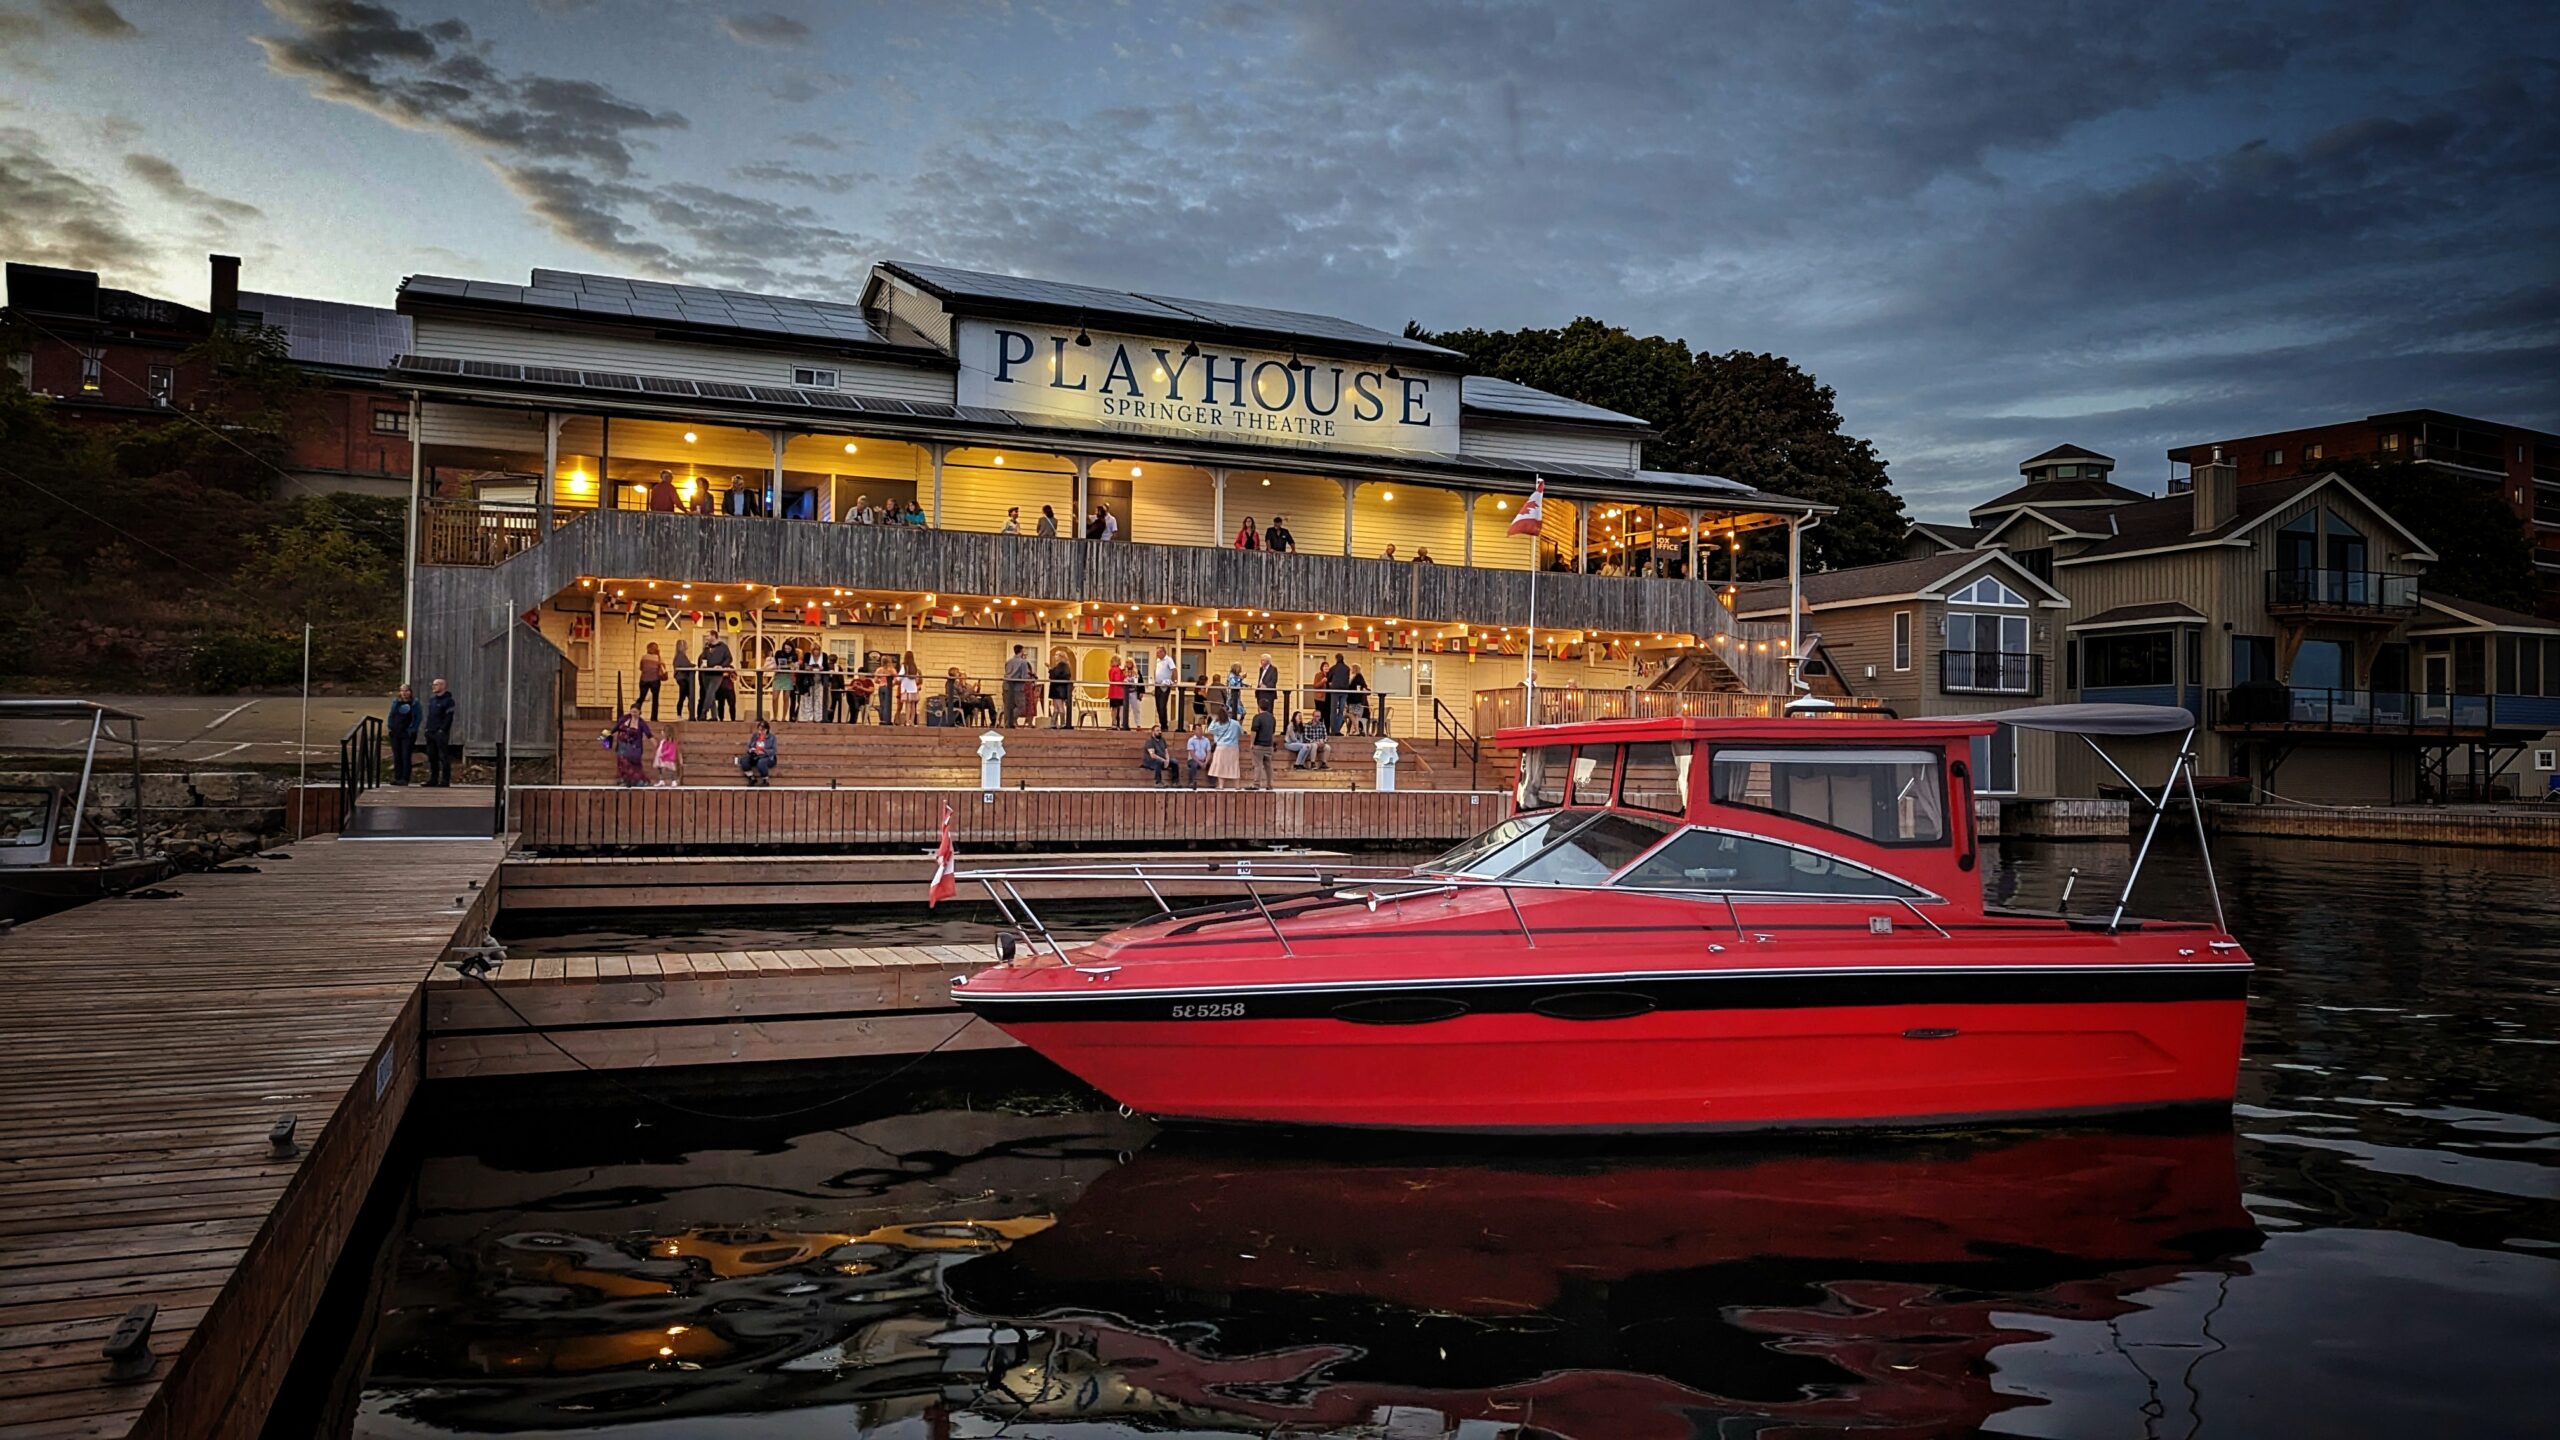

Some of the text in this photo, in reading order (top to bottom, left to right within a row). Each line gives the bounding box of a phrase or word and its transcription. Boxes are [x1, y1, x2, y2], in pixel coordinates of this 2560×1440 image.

[993, 329, 1432, 427] PLAYHOUSE
[1103, 397, 1336, 437] SPRINGER THEATRE
